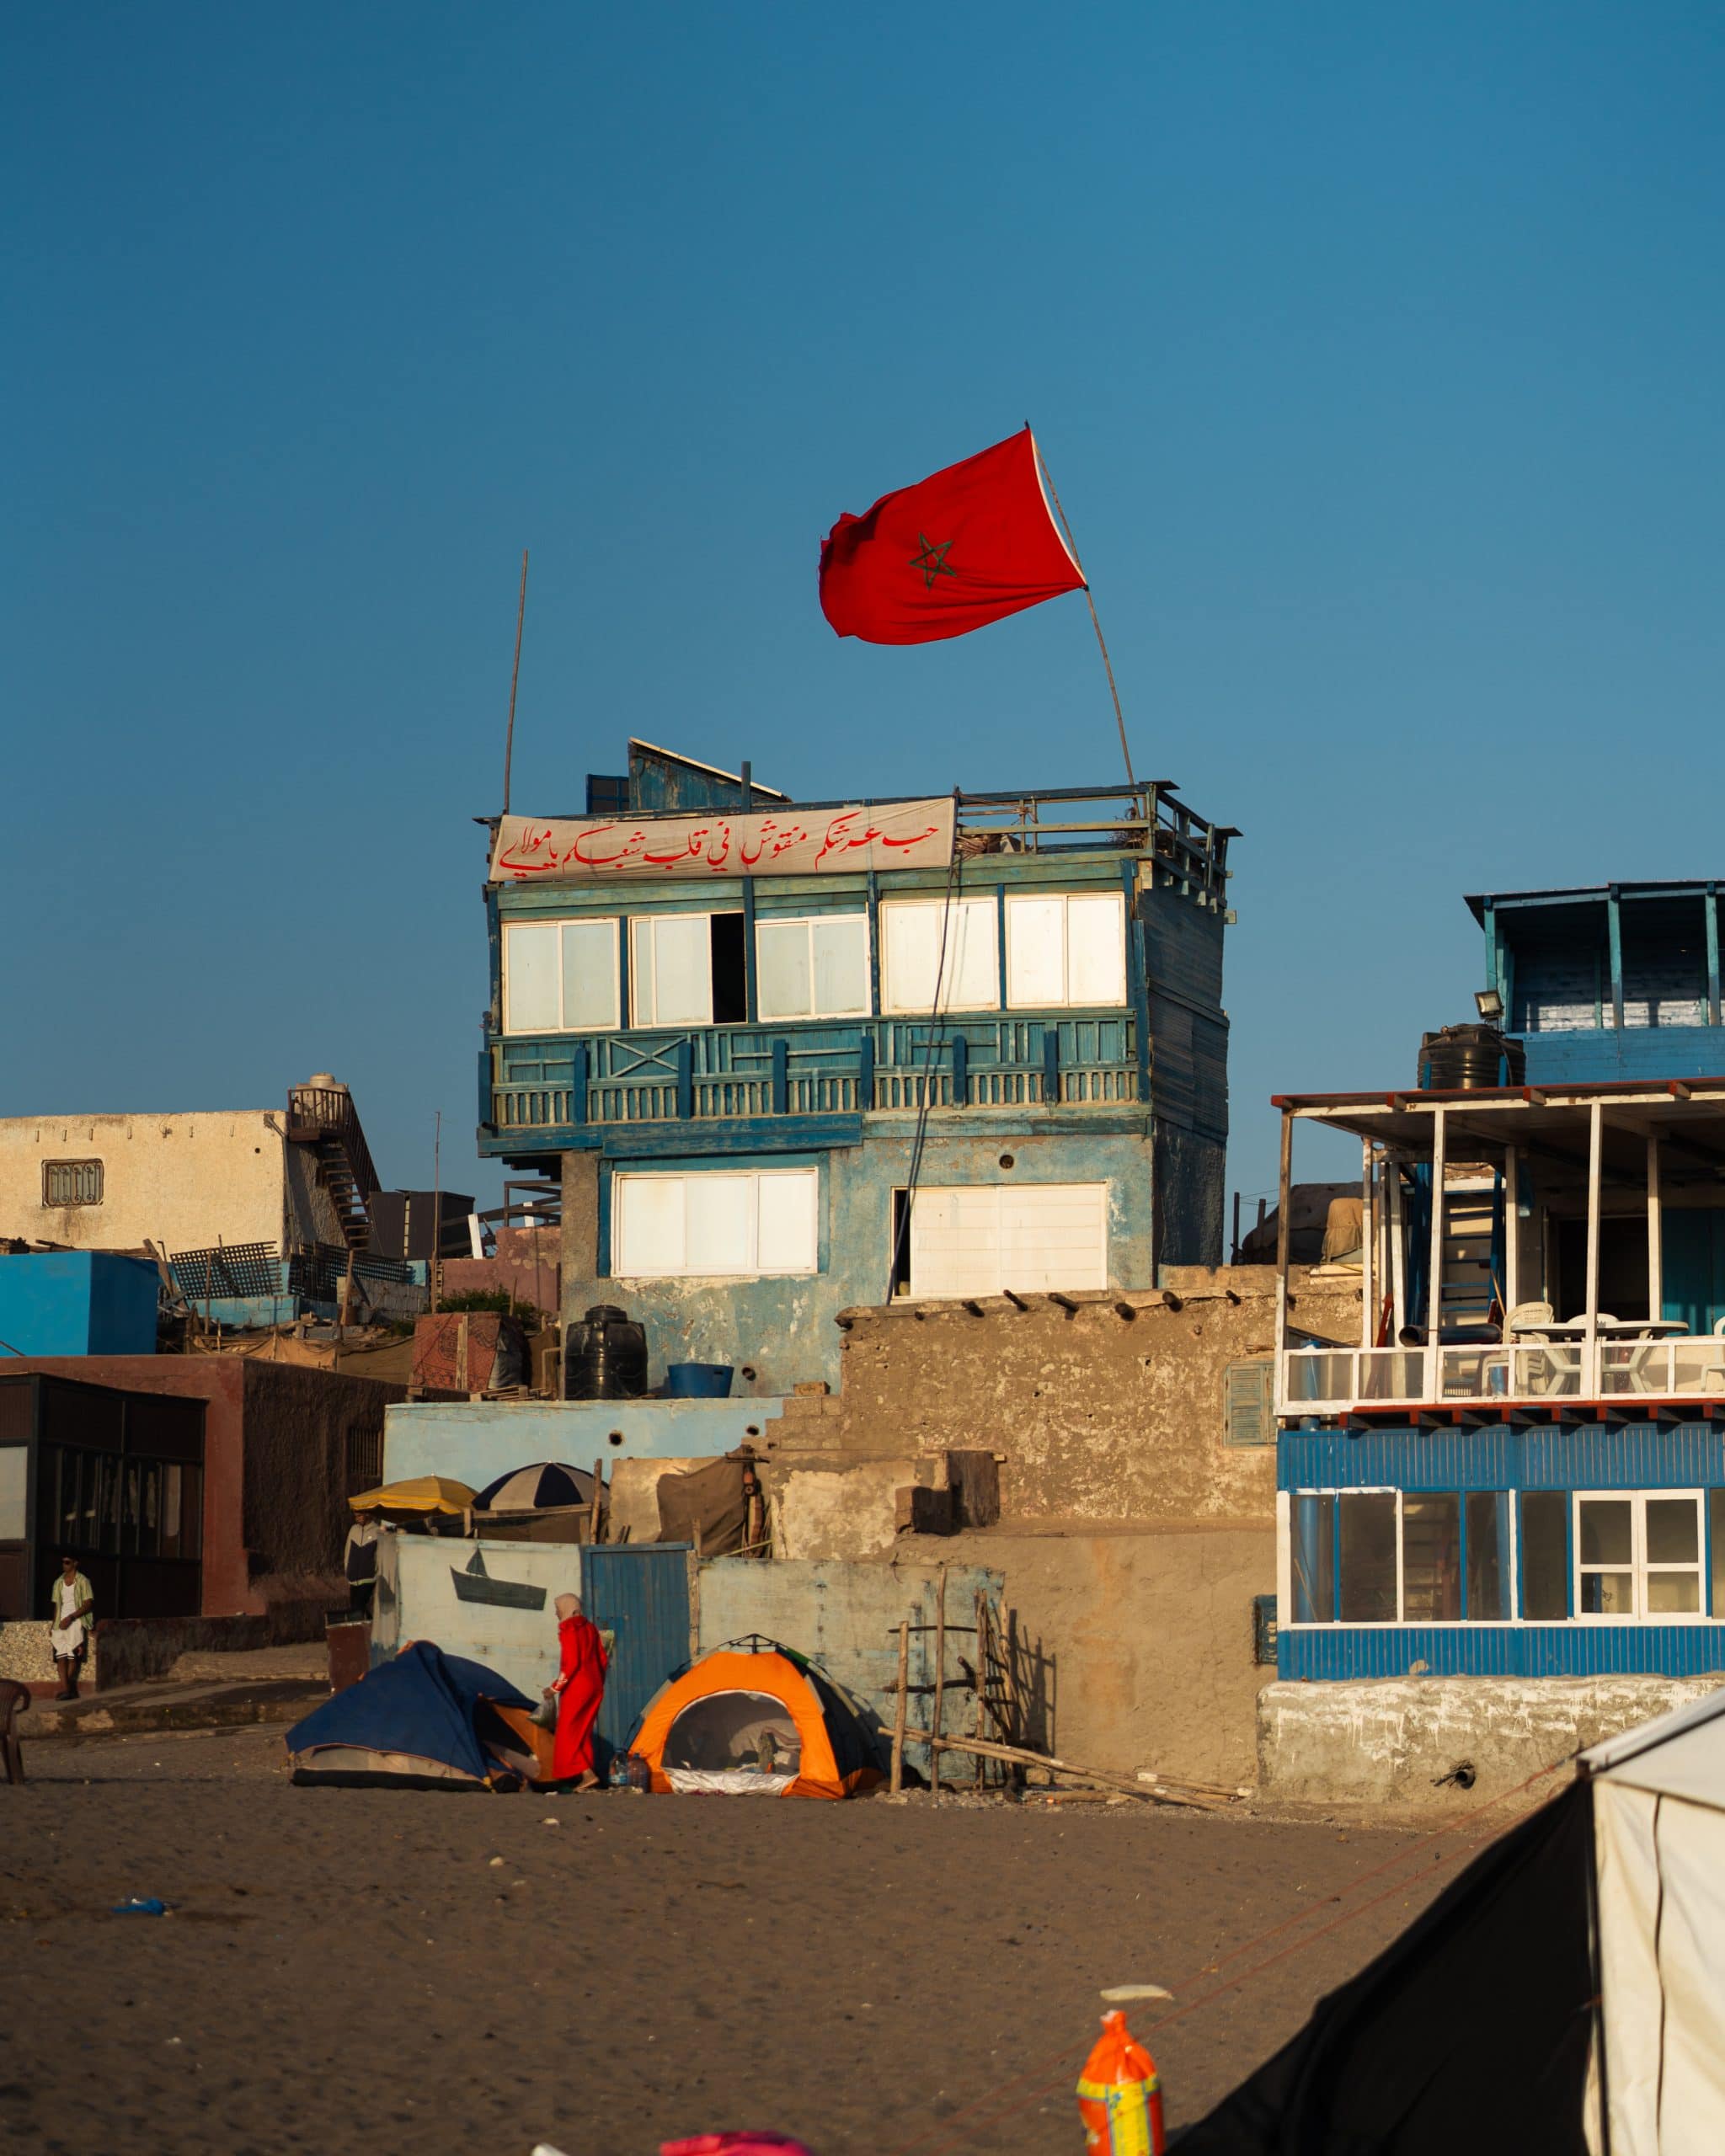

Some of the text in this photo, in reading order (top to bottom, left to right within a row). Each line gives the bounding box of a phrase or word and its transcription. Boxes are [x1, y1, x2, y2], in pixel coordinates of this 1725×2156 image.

[562, 825, 647, 874] شعبكم
[643, 828, 710, 871] قلب
[706, 820, 731, 873] في
[740, 819, 808, 867] منقوش
[814, 811, 883, 870] عرشكم
[881, 826, 939, 855] حب
